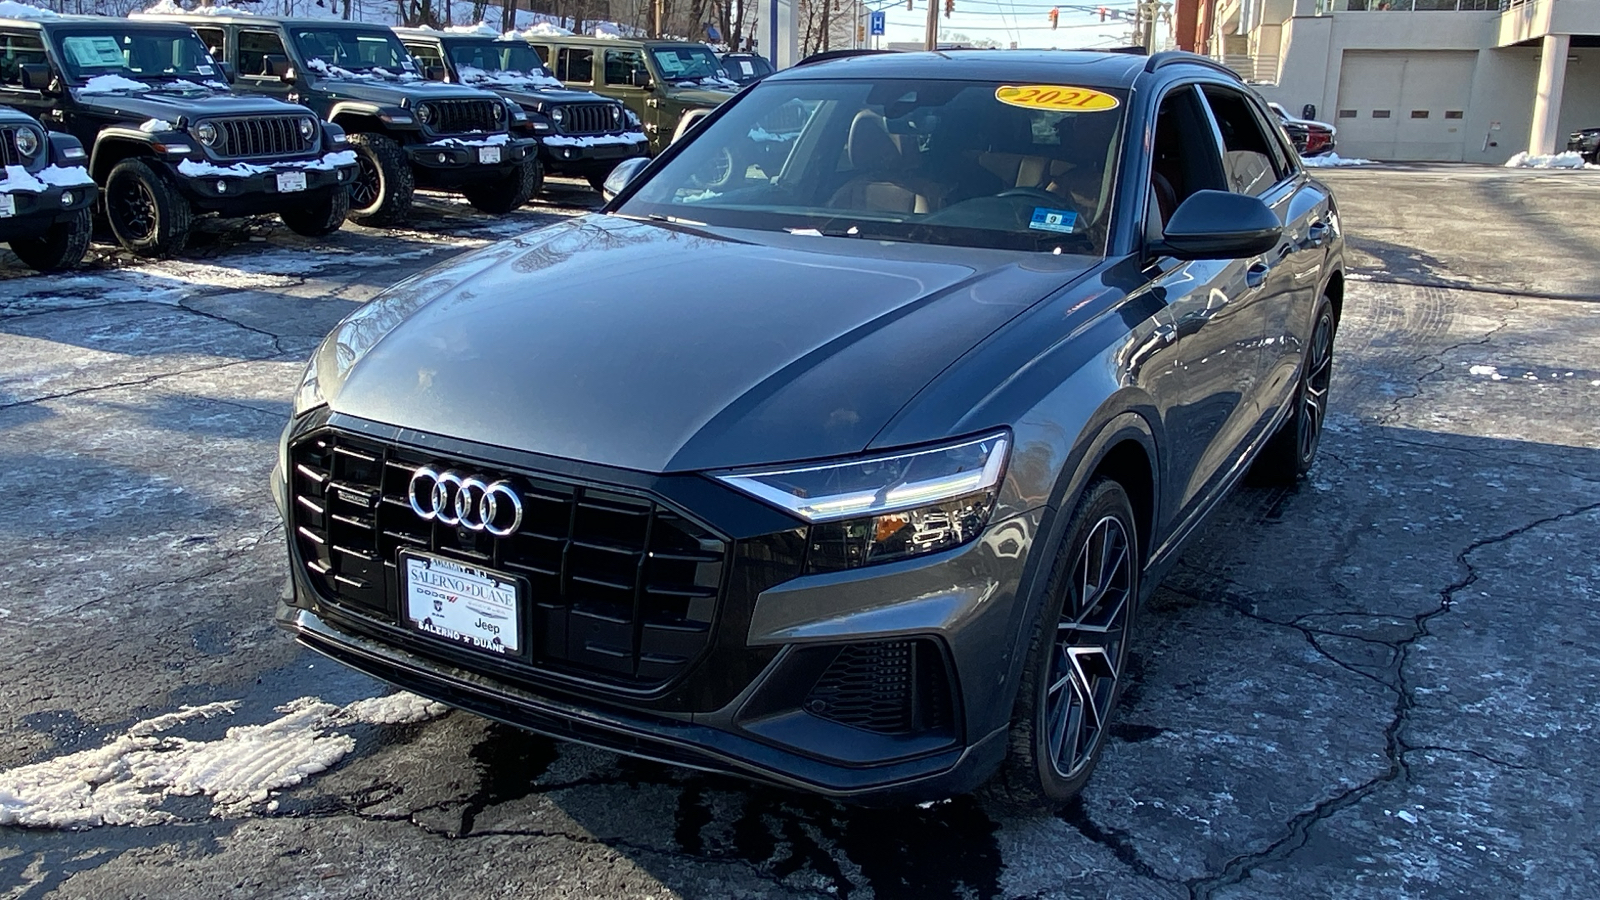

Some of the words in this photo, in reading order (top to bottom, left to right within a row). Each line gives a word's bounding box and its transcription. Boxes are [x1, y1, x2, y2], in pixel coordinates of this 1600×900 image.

[873, 17, 883, 29] H
[1014, 89, 1098, 107] 2021
[1050, 215, 1057, 223] 9
[411, 569, 465, 593] SALERNO
[471, 585, 513, 607] DUANE
[475, 618, 500, 635] Jeep
[418, 621, 460, 640] SALERNO
[474, 638, 505, 653] DUANE
